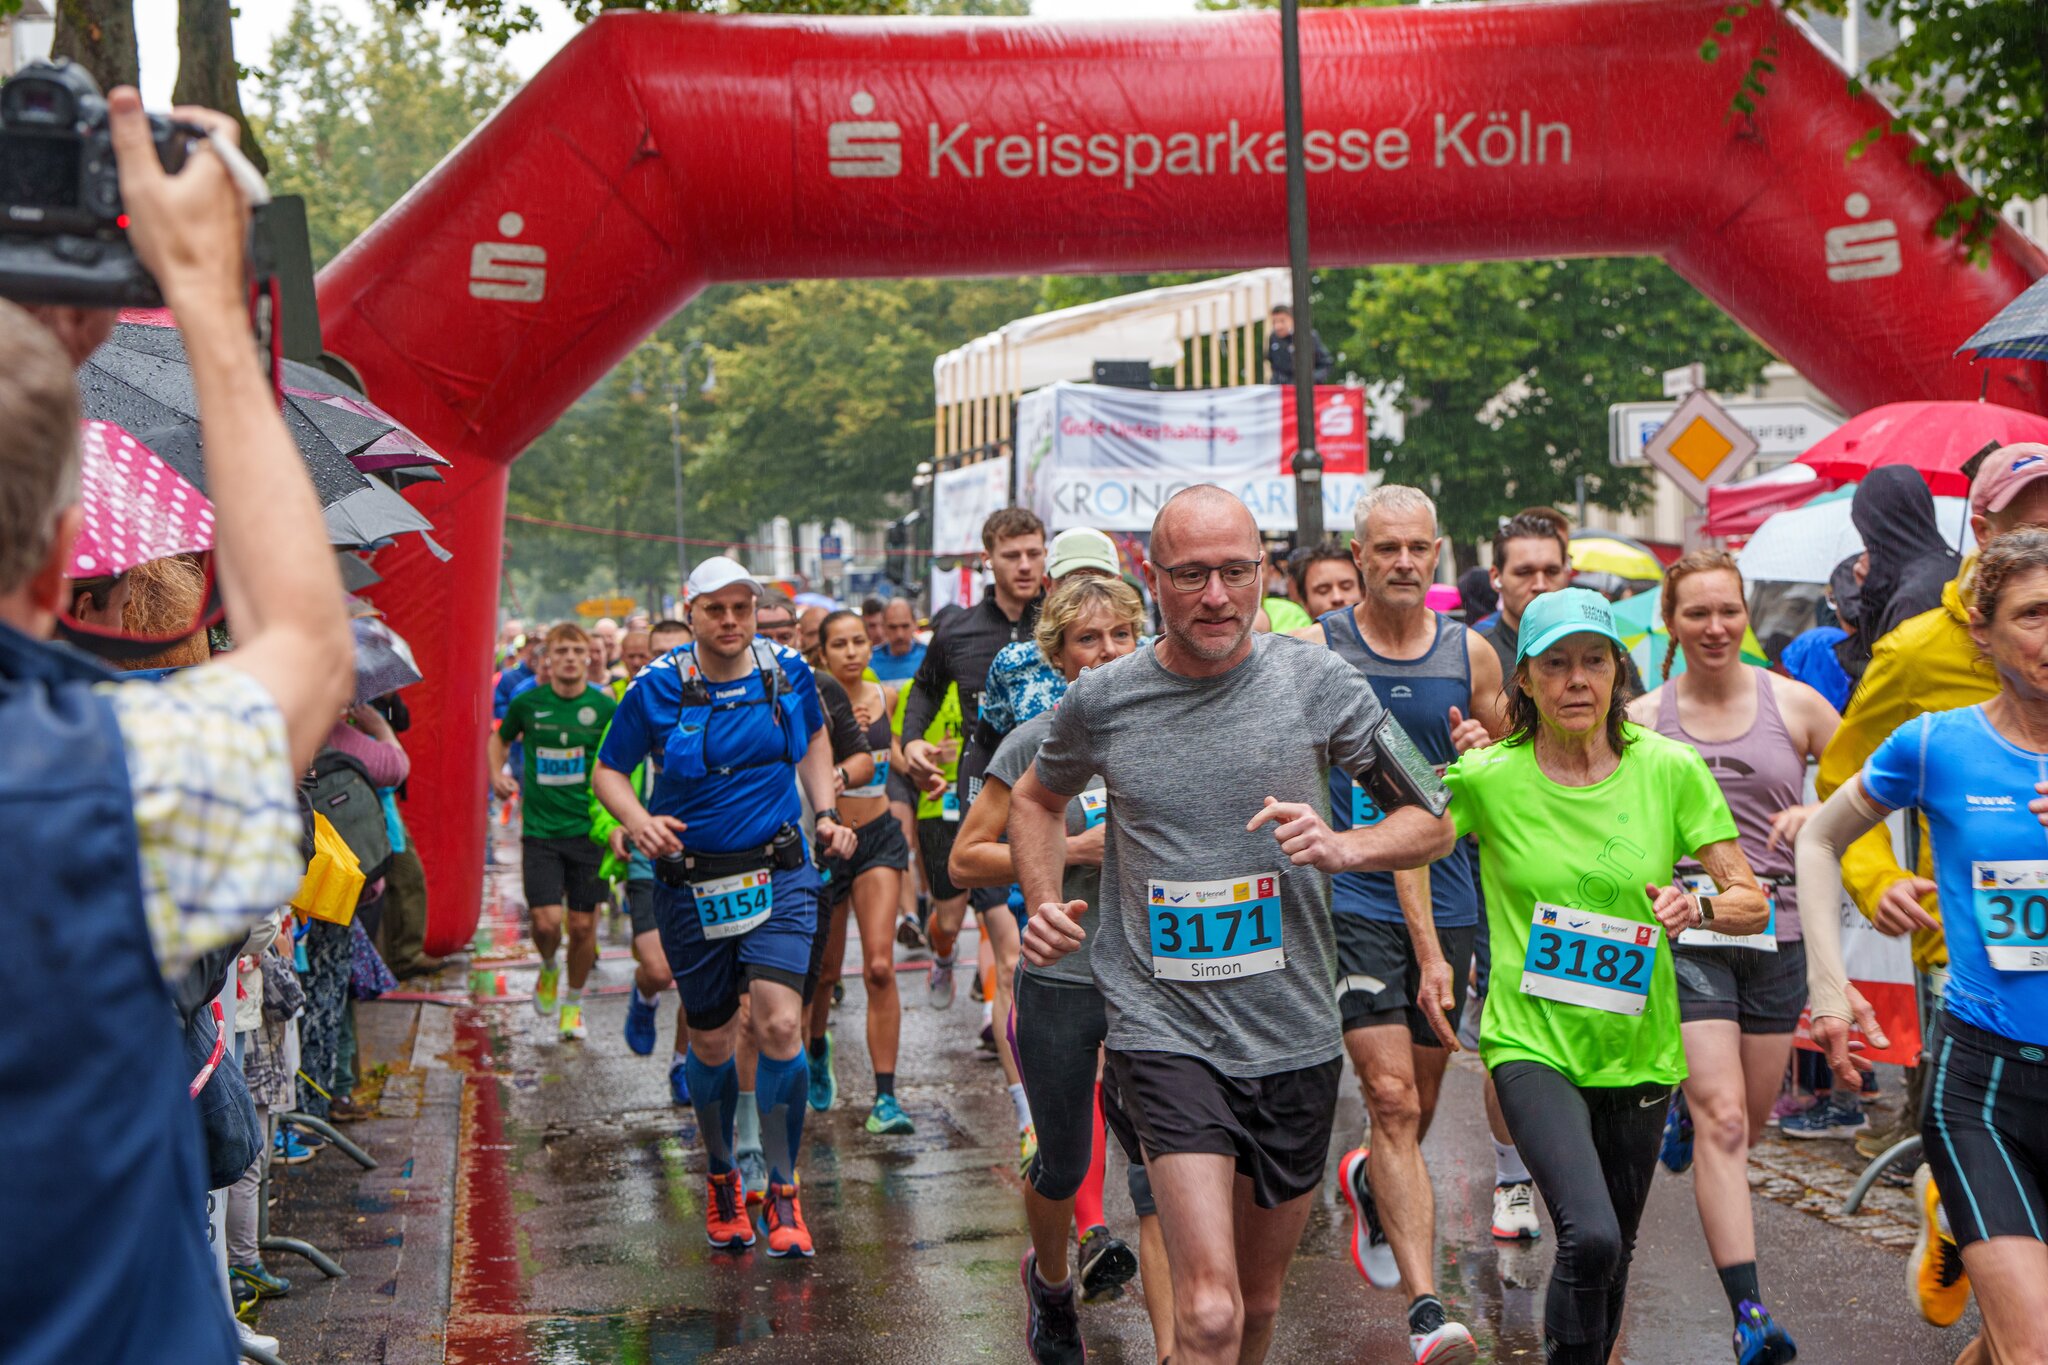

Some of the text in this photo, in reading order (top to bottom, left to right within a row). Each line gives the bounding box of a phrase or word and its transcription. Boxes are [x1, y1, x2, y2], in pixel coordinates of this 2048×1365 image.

[1433, 110, 1572, 170] Köln
[1238, 481, 1366, 516] ARNA
[542, 760, 580, 775] 3047
[702, 888, 768, 923] 3154
[1986, 895, 2048, 940] 30
[724, 920, 755, 933] Robert
[1158, 905, 1272, 953] 3171
[1191, 962, 1242, 977] Simon
[1534, 932, 1646, 989] 3182
